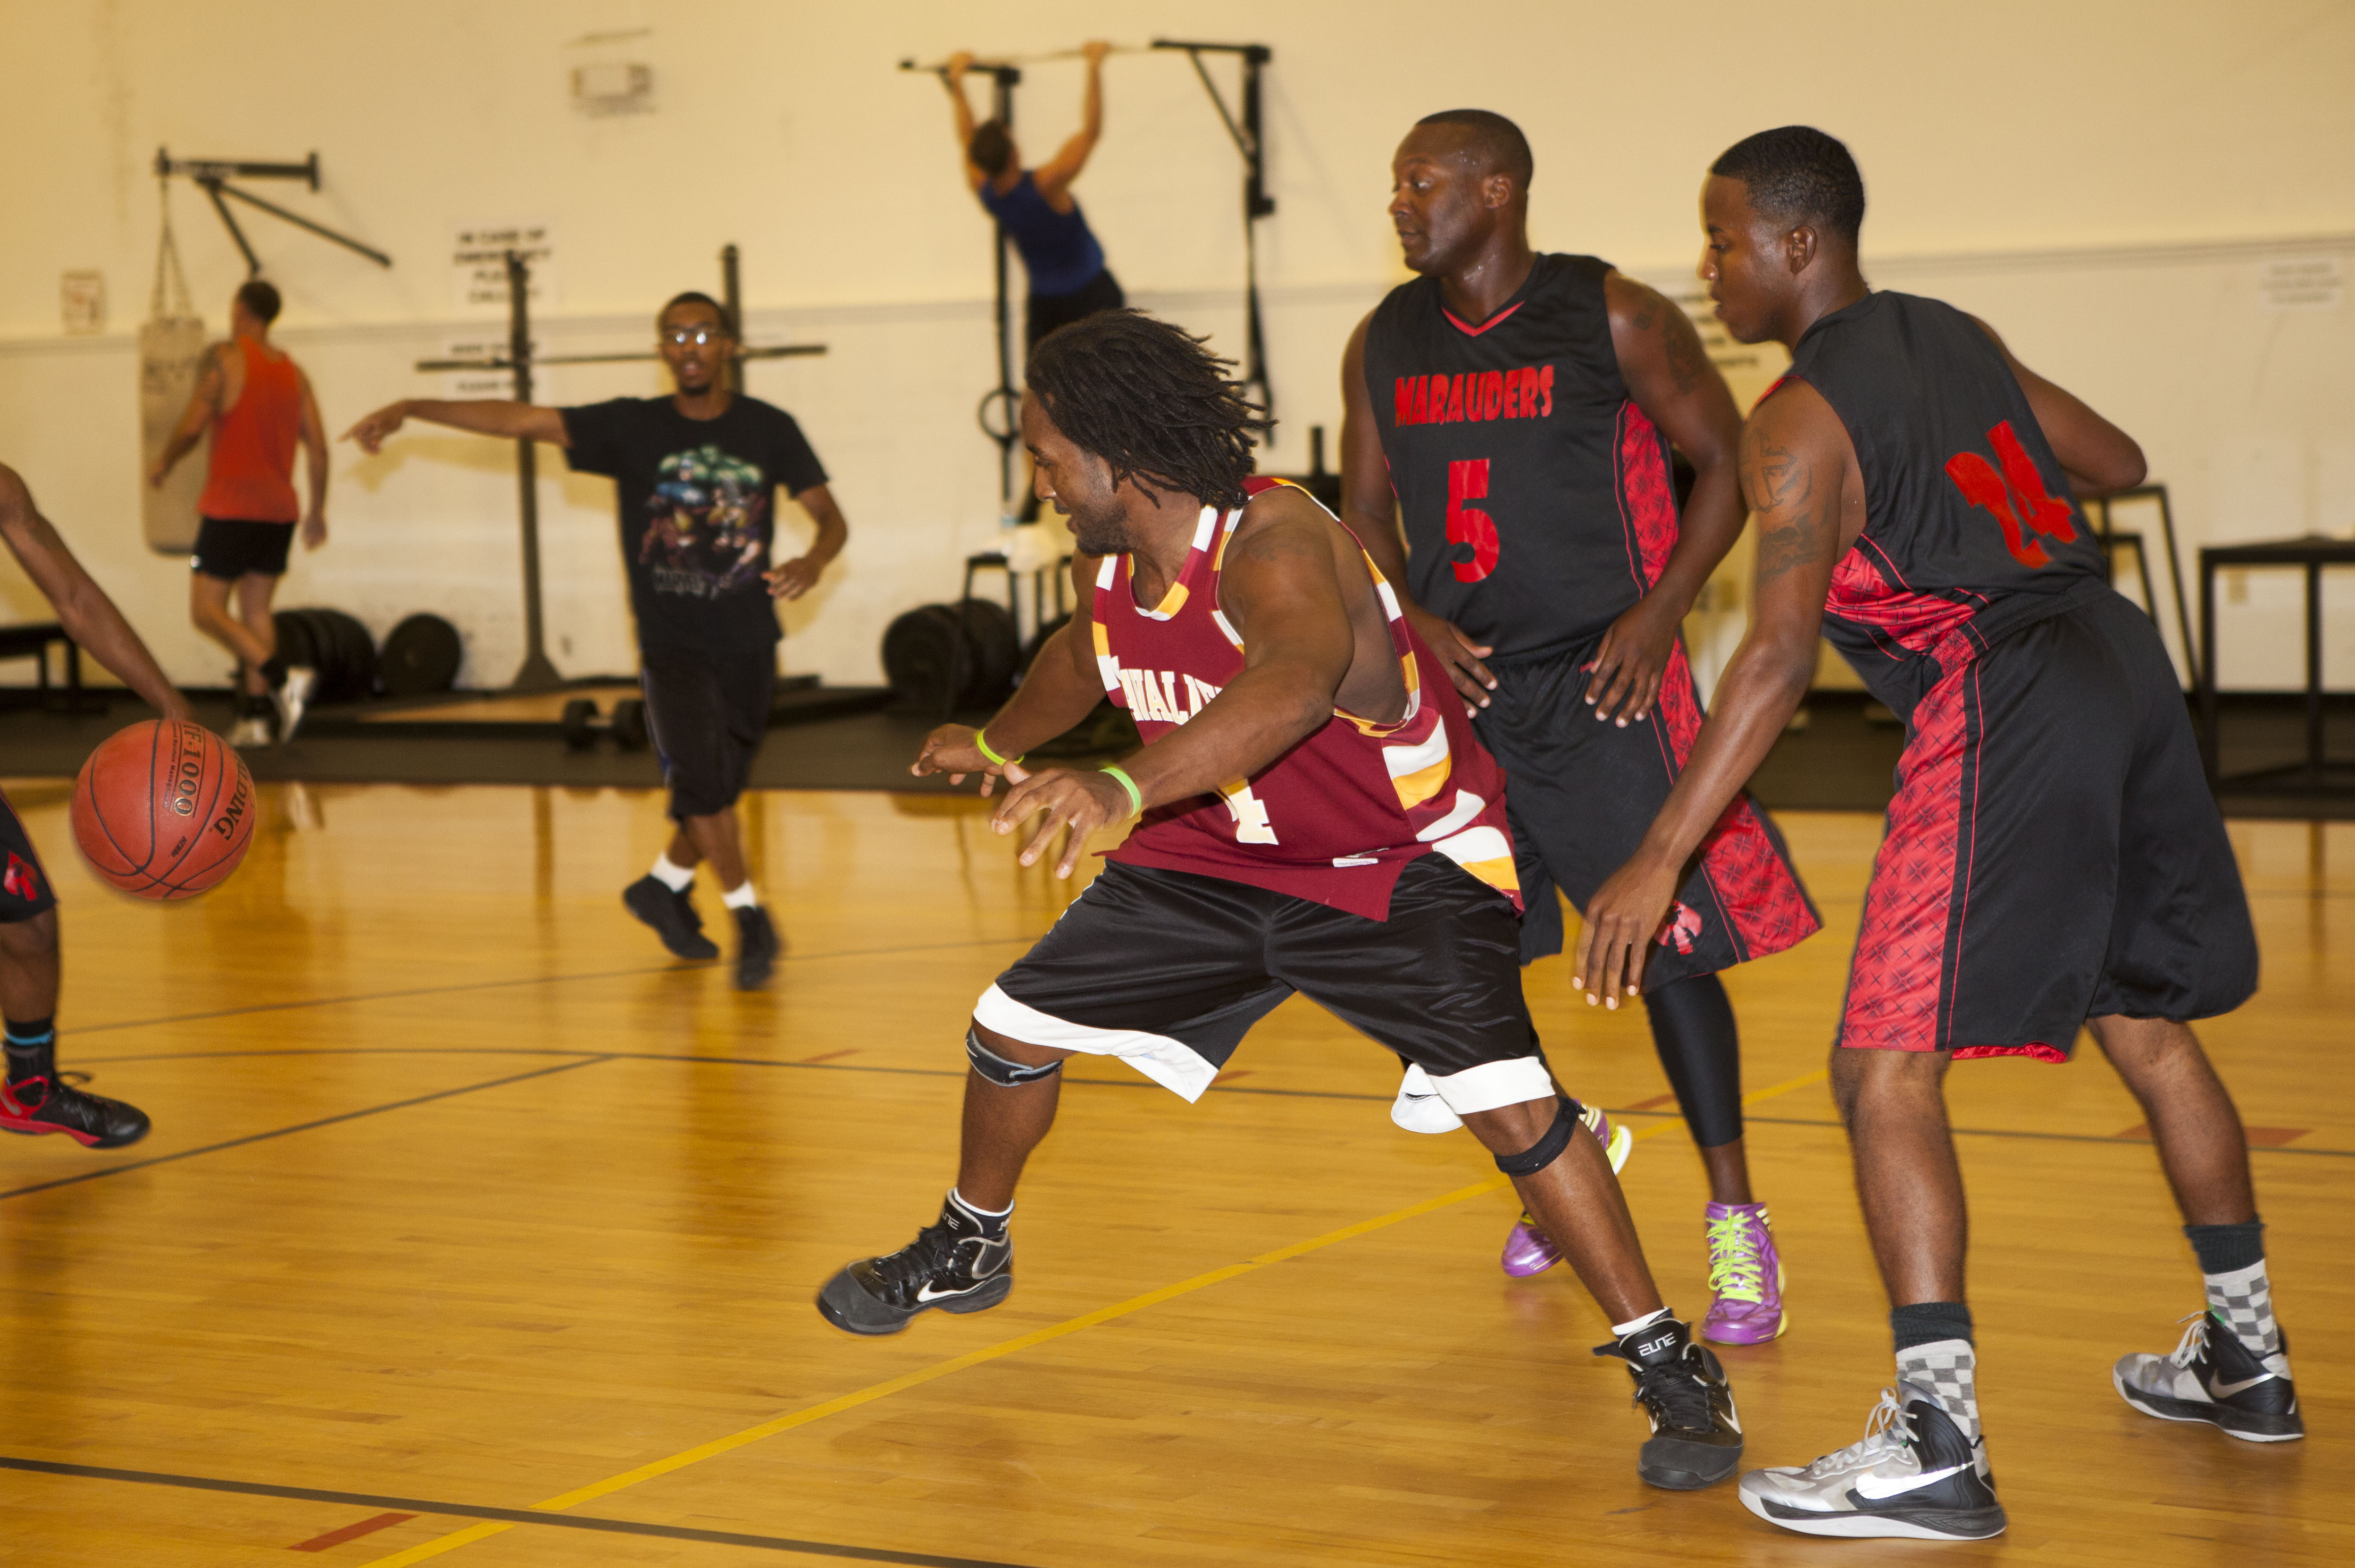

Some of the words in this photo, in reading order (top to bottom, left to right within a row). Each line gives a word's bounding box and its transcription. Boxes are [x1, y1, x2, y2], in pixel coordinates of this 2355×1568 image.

[1395, 365, 1554, 427] MARAUDERS
[1446, 459, 1499, 583] 5
[1944, 420, 2078, 570] 24
[1637, 1332, 1677, 1357] ELITE
